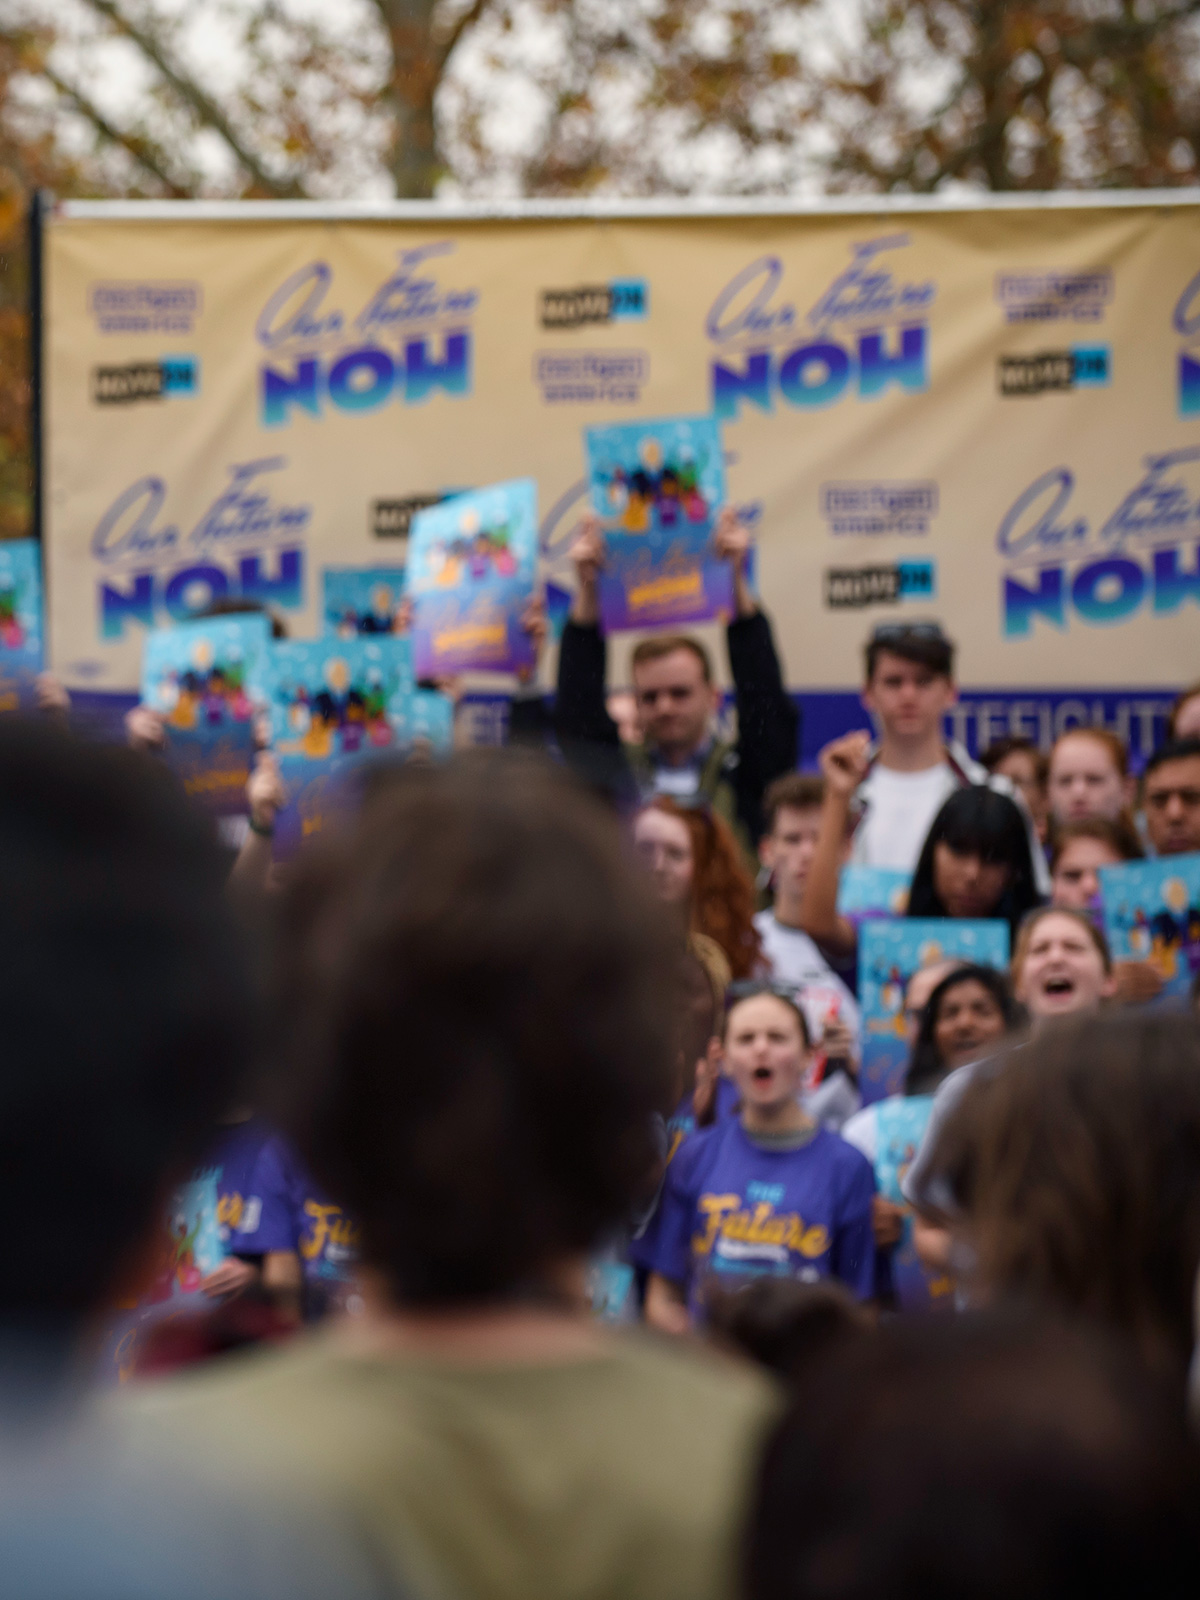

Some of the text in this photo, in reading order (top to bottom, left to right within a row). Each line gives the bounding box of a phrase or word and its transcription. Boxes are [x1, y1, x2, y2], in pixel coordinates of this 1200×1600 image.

[257, 258, 343, 348] Our
[706, 255, 795, 342] Our
[263, 329, 470, 427] NOW
[712, 323, 930, 421] NOW
[92, 473, 179, 561] Our
[997, 465, 1089, 556] Our
[101, 545, 303, 640] NOW
